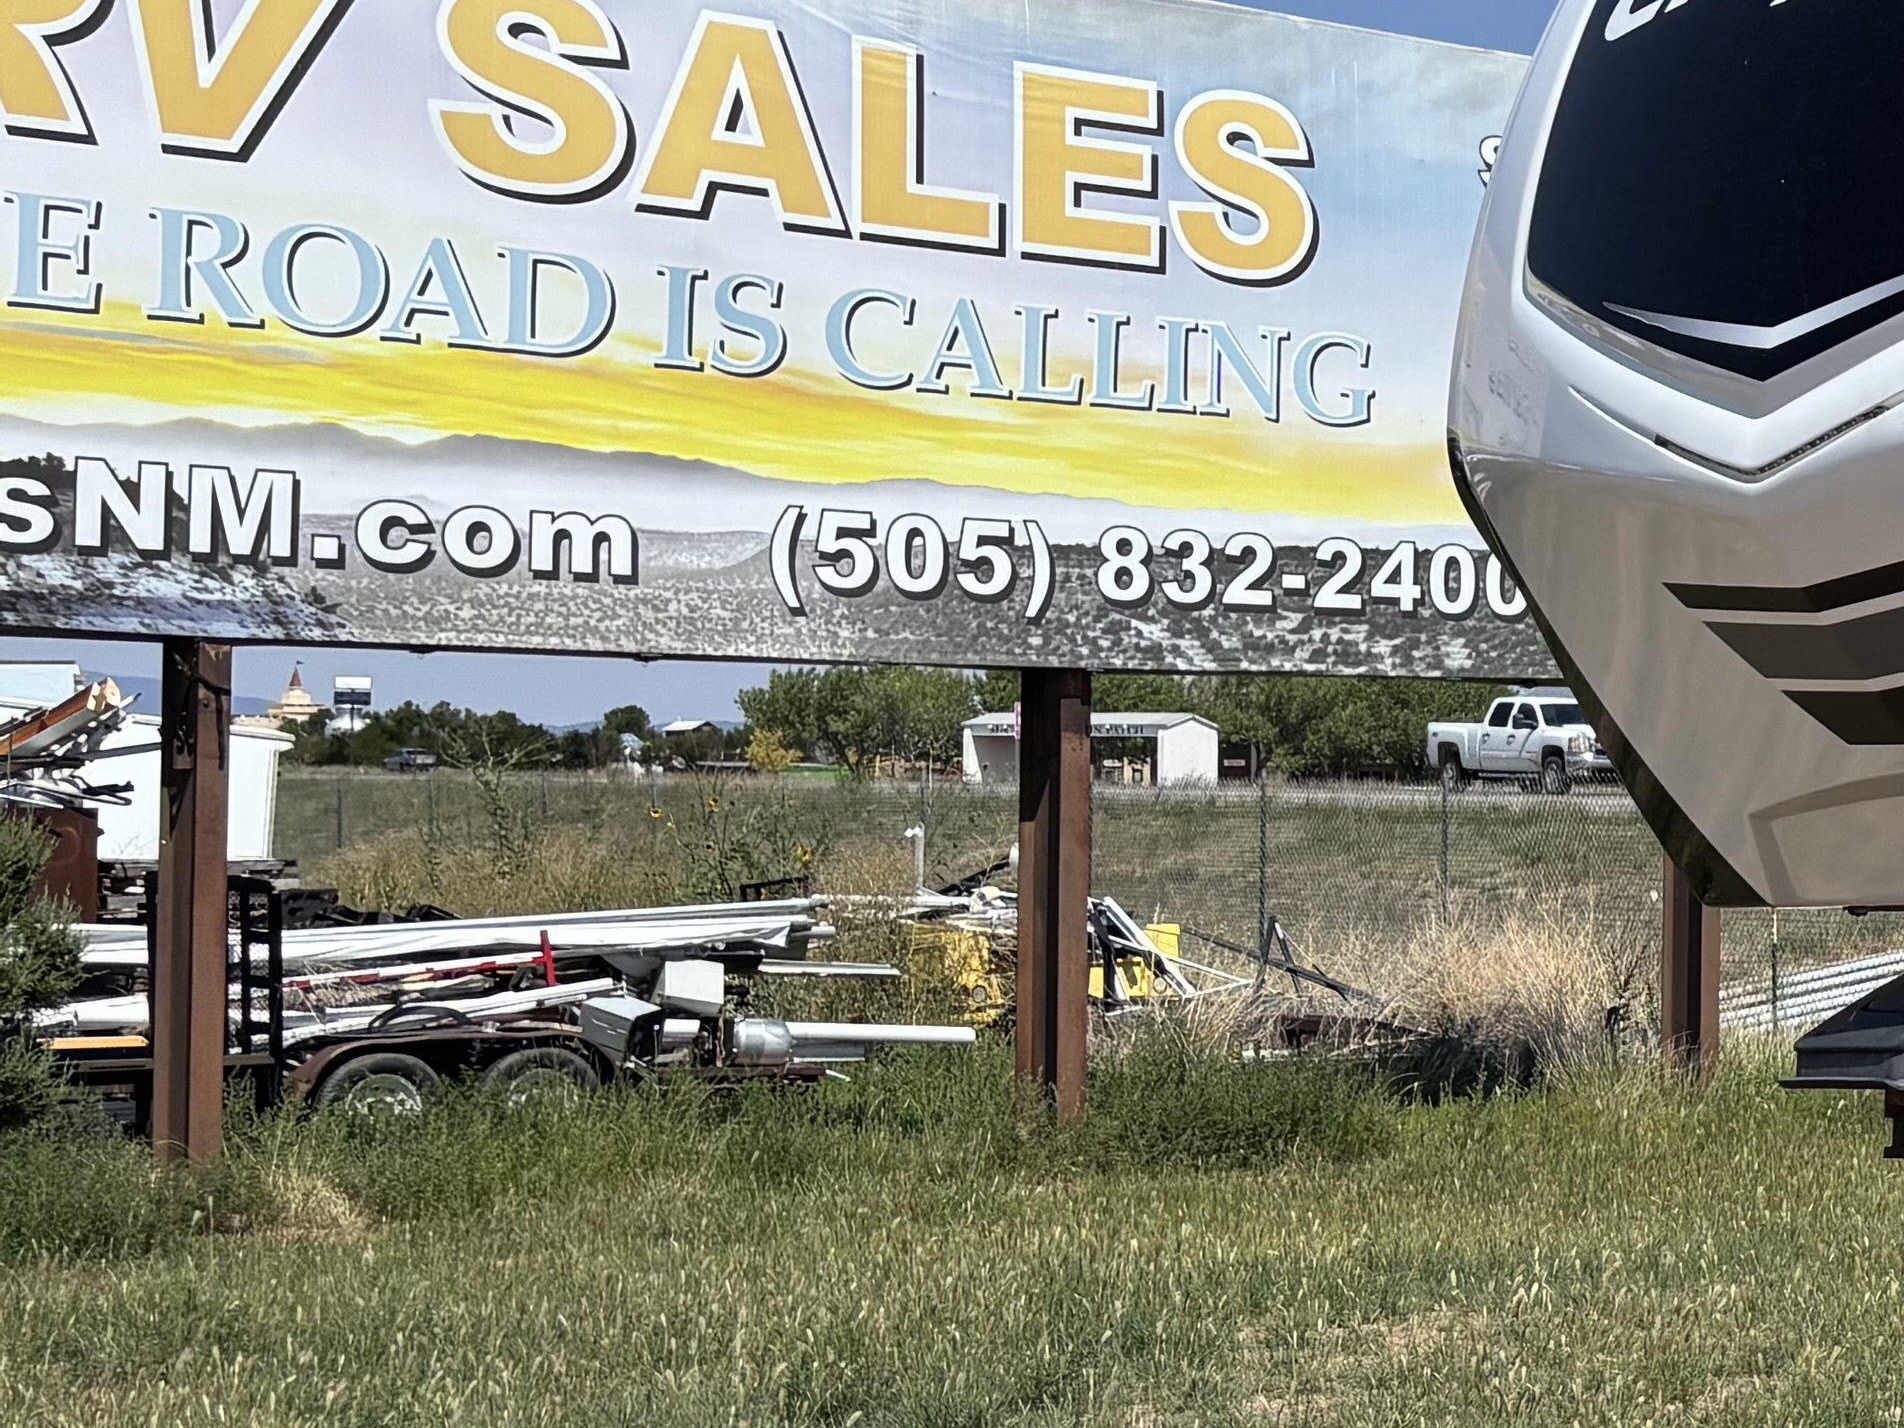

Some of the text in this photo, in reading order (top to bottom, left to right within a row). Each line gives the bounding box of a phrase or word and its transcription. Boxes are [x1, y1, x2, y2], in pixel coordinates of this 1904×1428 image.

[143, 206, 616, 358] ROAD
[653, 264, 787, 378] IS
[824, 288, 1376, 428] CALLING
[0, 456, 640, 586] sNM.com
[769, 504, 1055, 624] (505)
